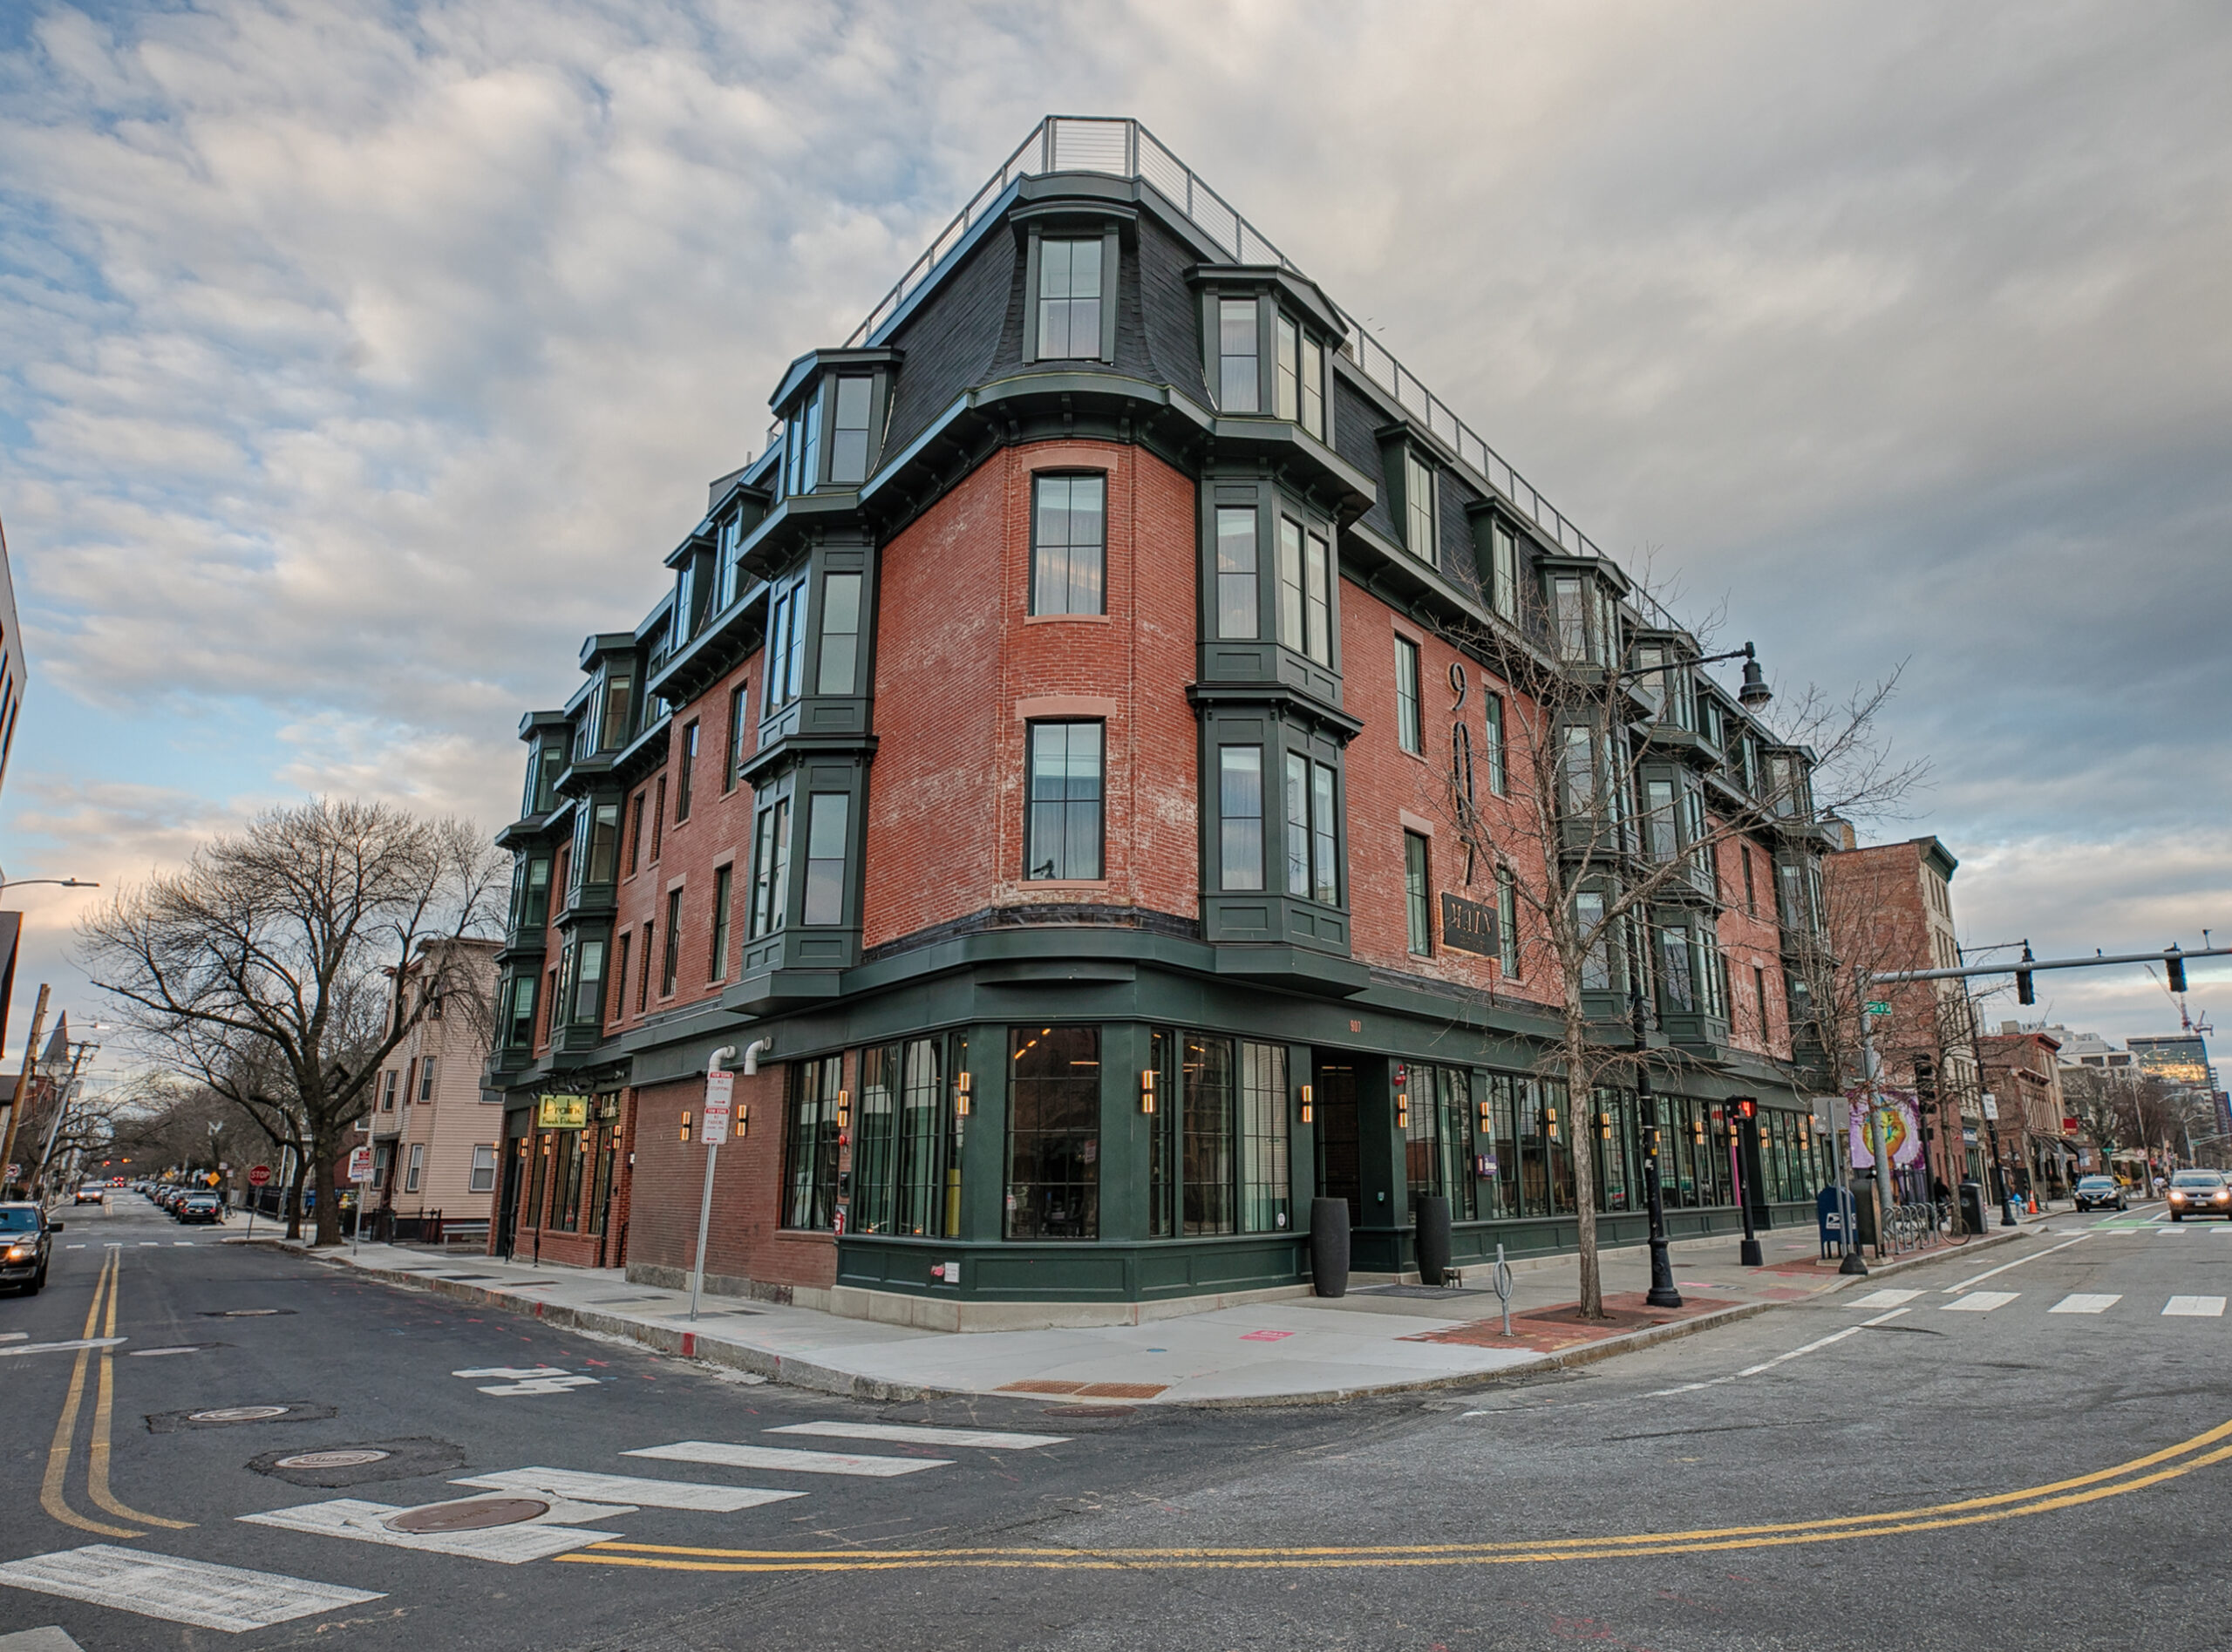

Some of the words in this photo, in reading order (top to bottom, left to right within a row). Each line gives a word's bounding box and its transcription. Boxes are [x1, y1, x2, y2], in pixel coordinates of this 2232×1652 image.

[1448, 662, 1477, 887] 907
[1349, 1019, 1361, 1033] 907
[251, 1170, 271, 1179] STOP
